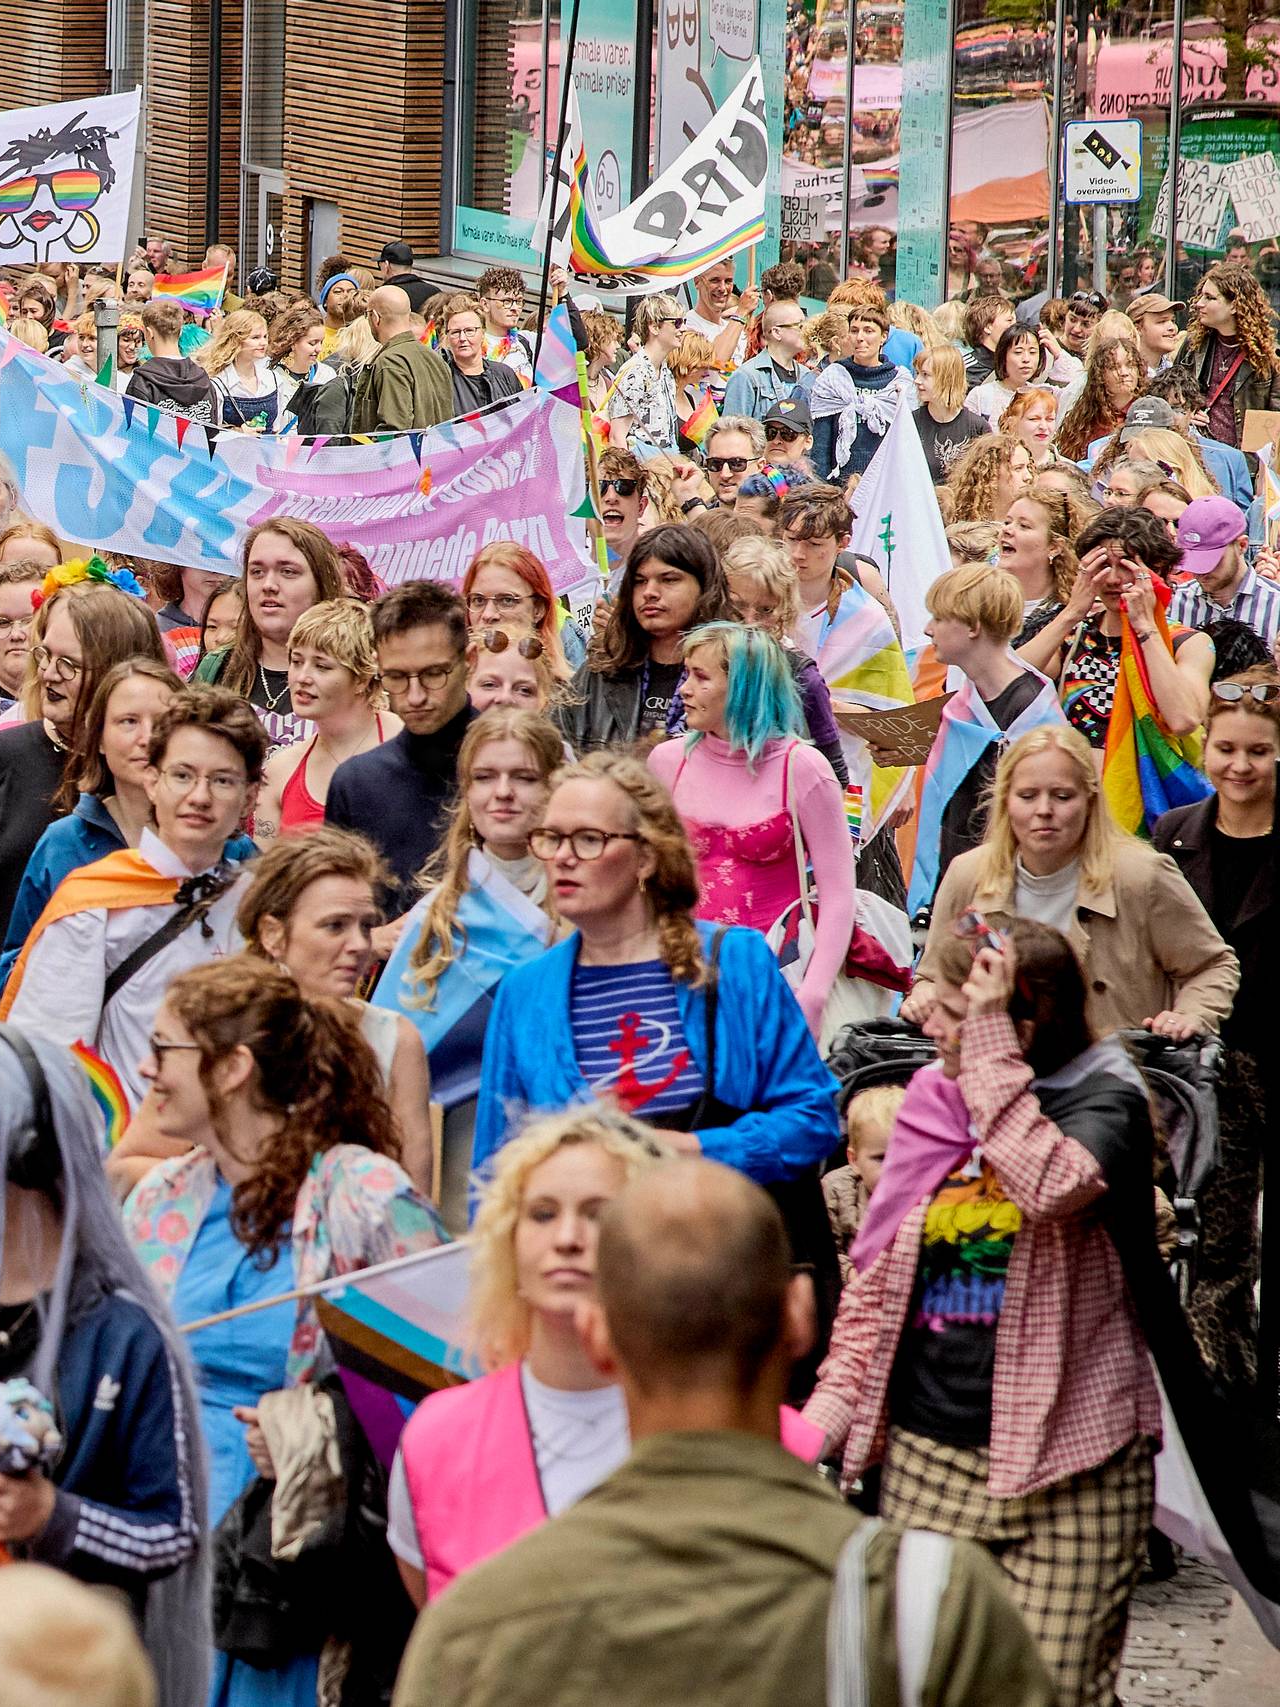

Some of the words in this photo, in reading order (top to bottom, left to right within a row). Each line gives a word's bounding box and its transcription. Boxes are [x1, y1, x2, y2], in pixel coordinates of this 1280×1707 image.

[566, 36, 601, 62] ormale
[572, 68, 604, 94] ormale
[606, 71, 631, 99] priser
[1076, 186, 1131, 196] overvågning
[1089, 177, 1117, 185] Video-
[266, 223, 274, 256] 9
[849, 712, 930, 737] PRIDE
[898, 735, 916, 745] IS
